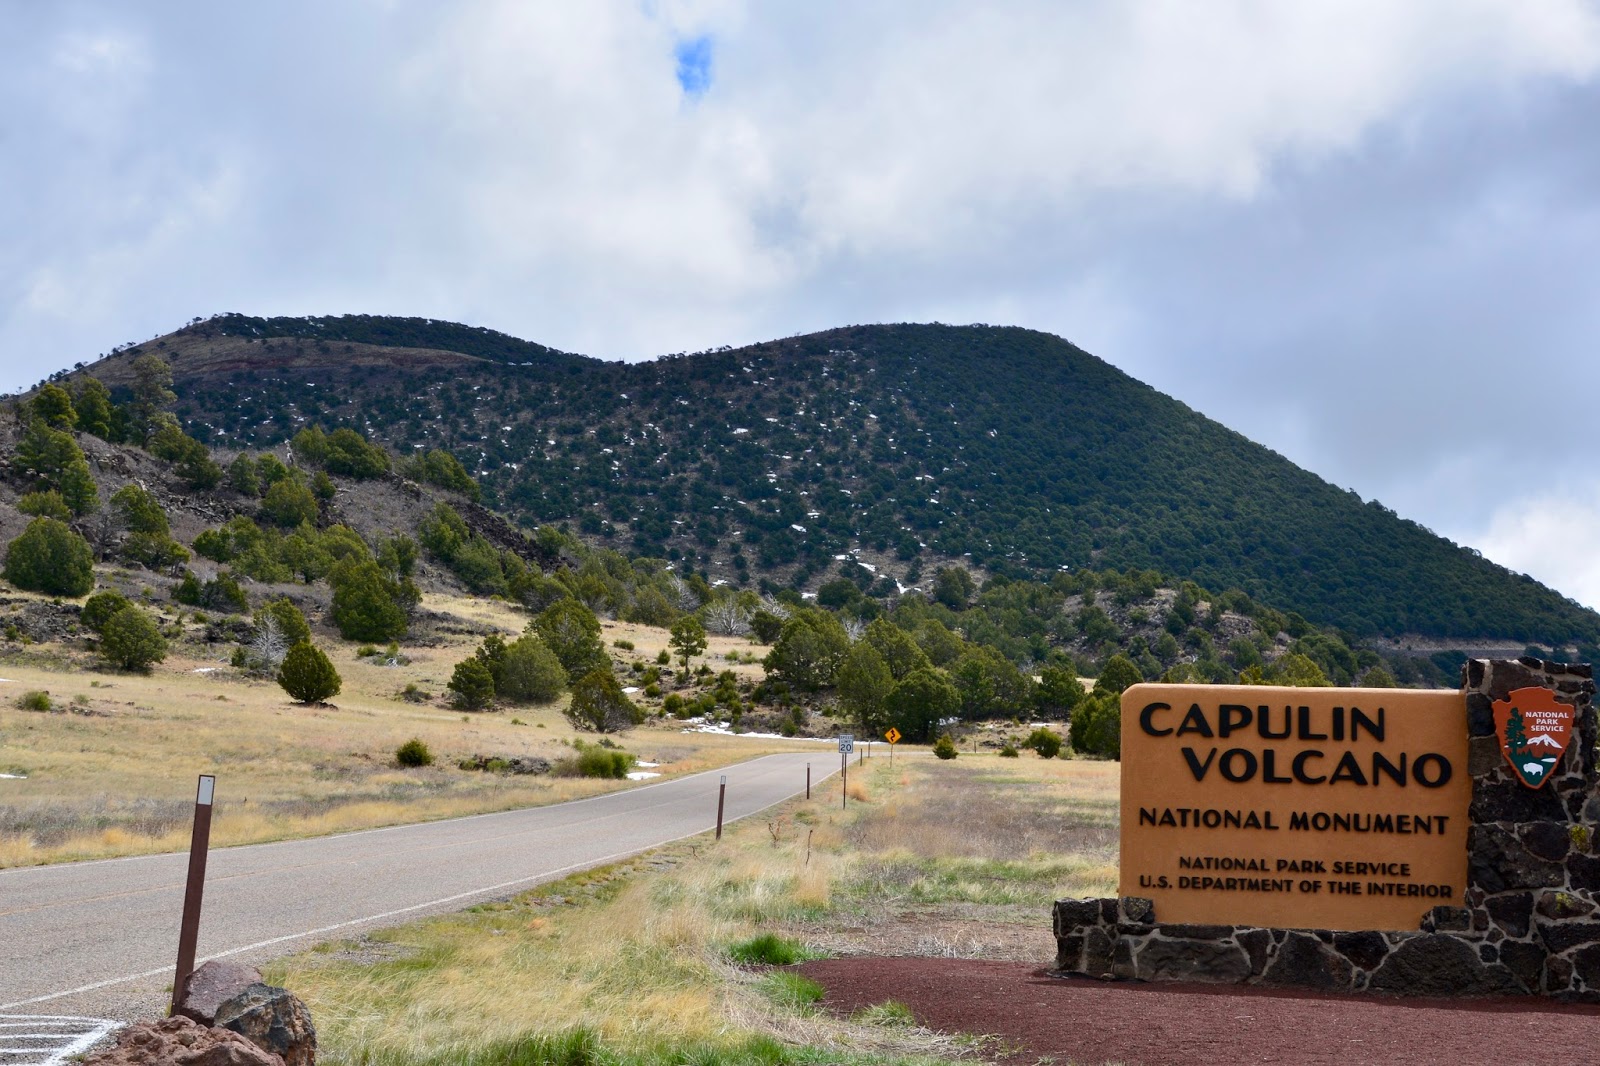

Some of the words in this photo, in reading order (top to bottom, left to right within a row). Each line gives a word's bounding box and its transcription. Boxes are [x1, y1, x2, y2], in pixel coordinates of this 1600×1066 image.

[1139, 702, 1385, 742] CAPULIN
[840, 744, 852, 752] 20
[1181, 747, 1453, 788] VOLCANO
[1139, 807, 1279, 830] NATIONAL
[1289, 811, 1449, 835] MONUMENT
[1179, 856, 1270, 873] NATIONAL
[1276, 859, 1326, 874] PARK
[1333, 861, 1411, 877] SERVICE
[1140, 875, 1173, 889] U.S.
[1178, 876, 1294, 894] DEPARTMENT
[1299, 880, 1322, 894] OF
[1327, 881, 1361, 896] THE
[1367, 882, 1453, 898] INTERIOR
